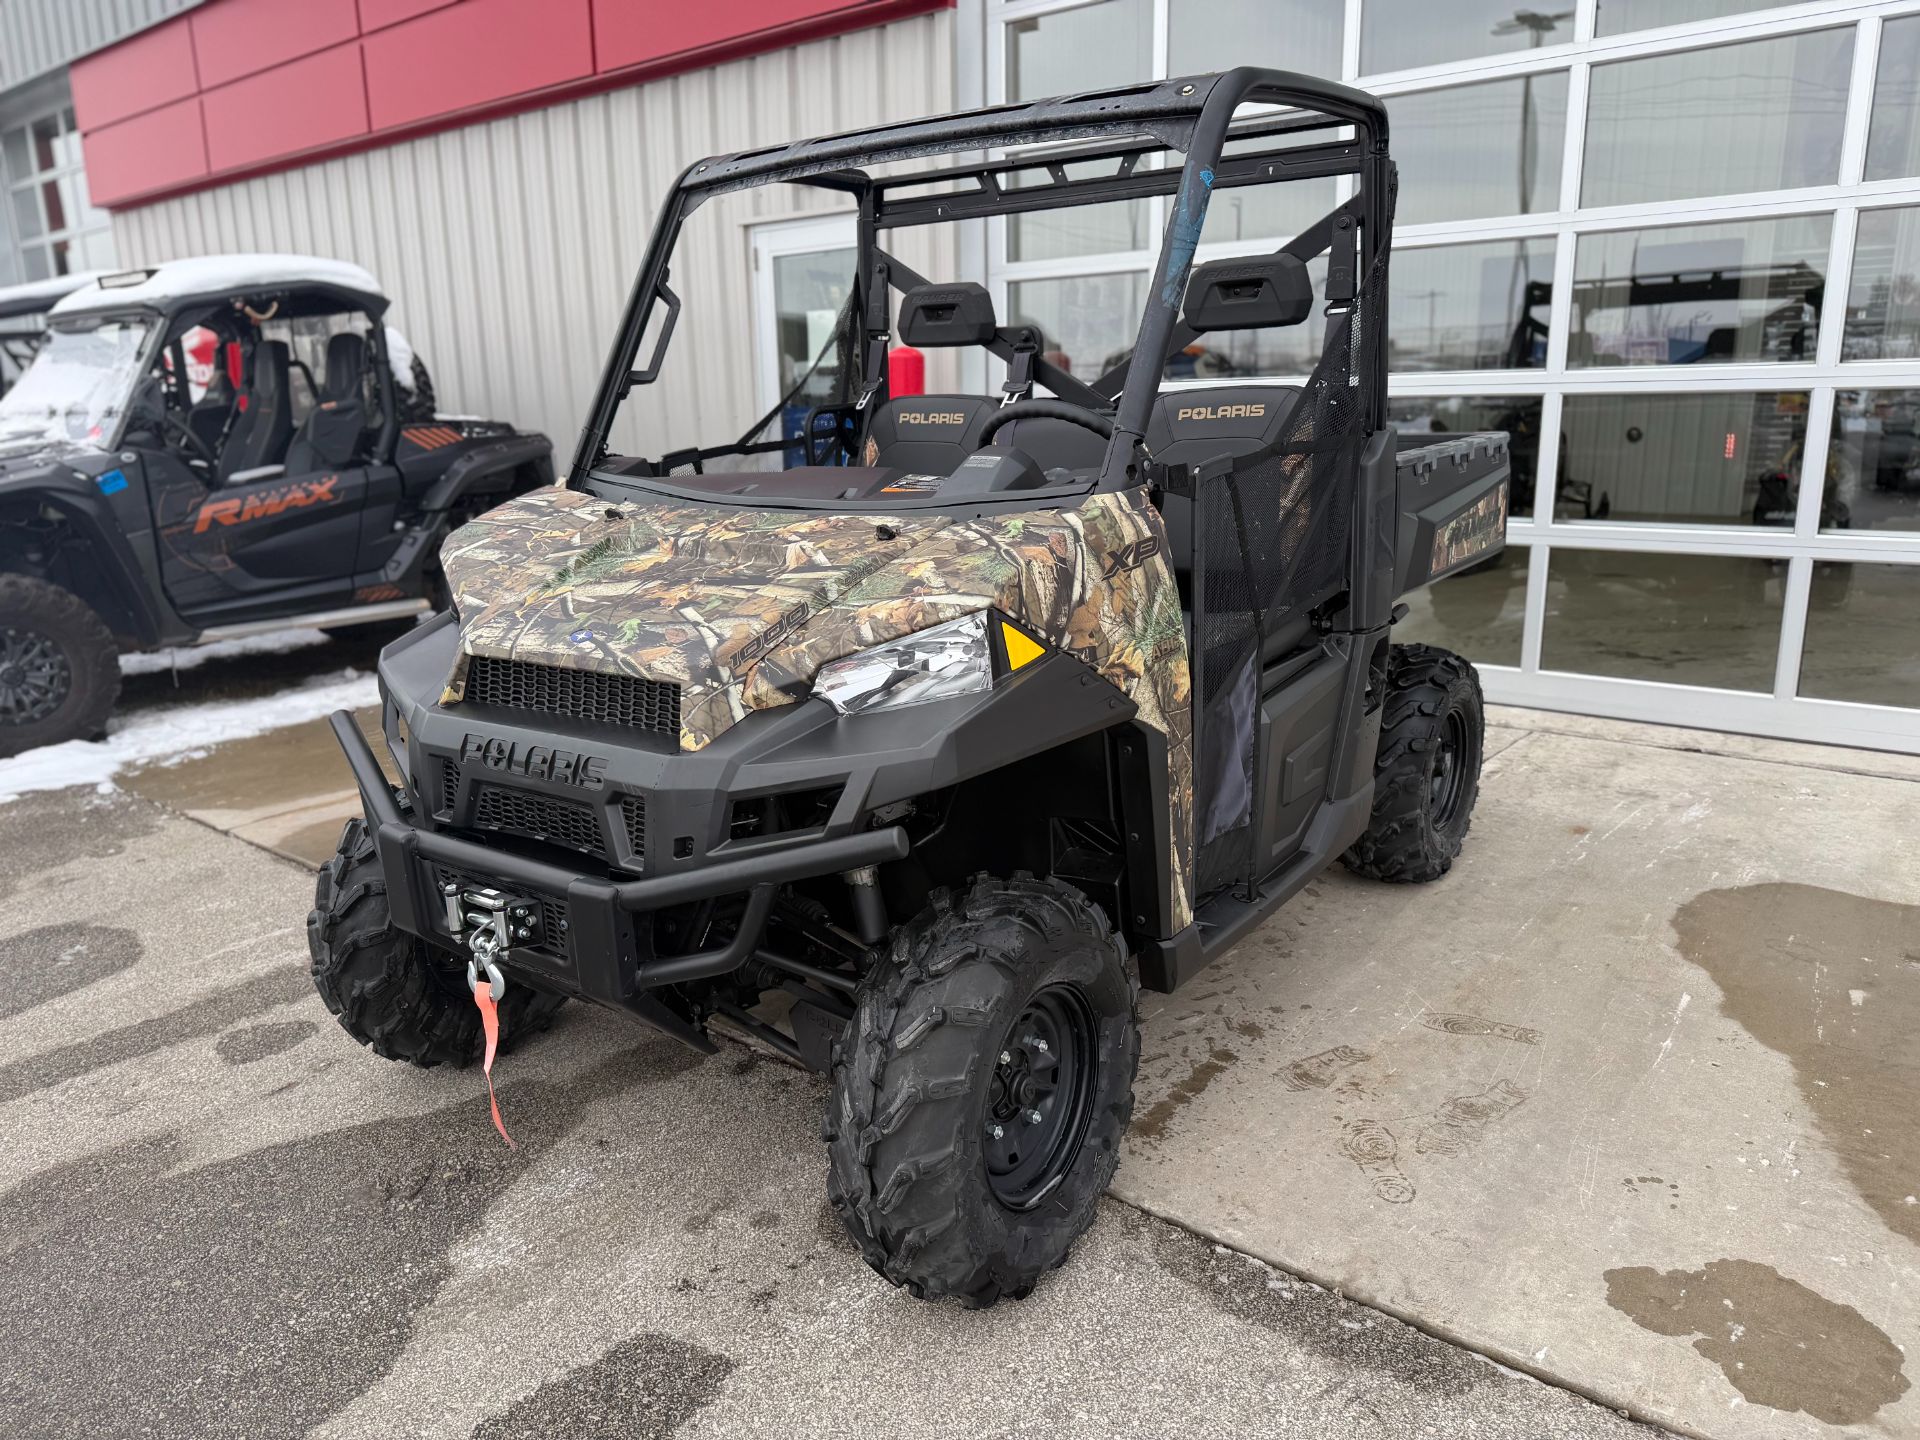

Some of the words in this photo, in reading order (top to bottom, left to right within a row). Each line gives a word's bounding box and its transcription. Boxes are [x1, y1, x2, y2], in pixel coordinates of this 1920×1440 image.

[899, 412, 965, 425] POLARIS
[1178, 404, 1265, 421] POLARIS
[193, 475, 338, 534] RMAX
[1101, 535, 1160, 581] XP
[729, 601, 810, 670] 1000
[460, 733, 610, 792] POLARIS
